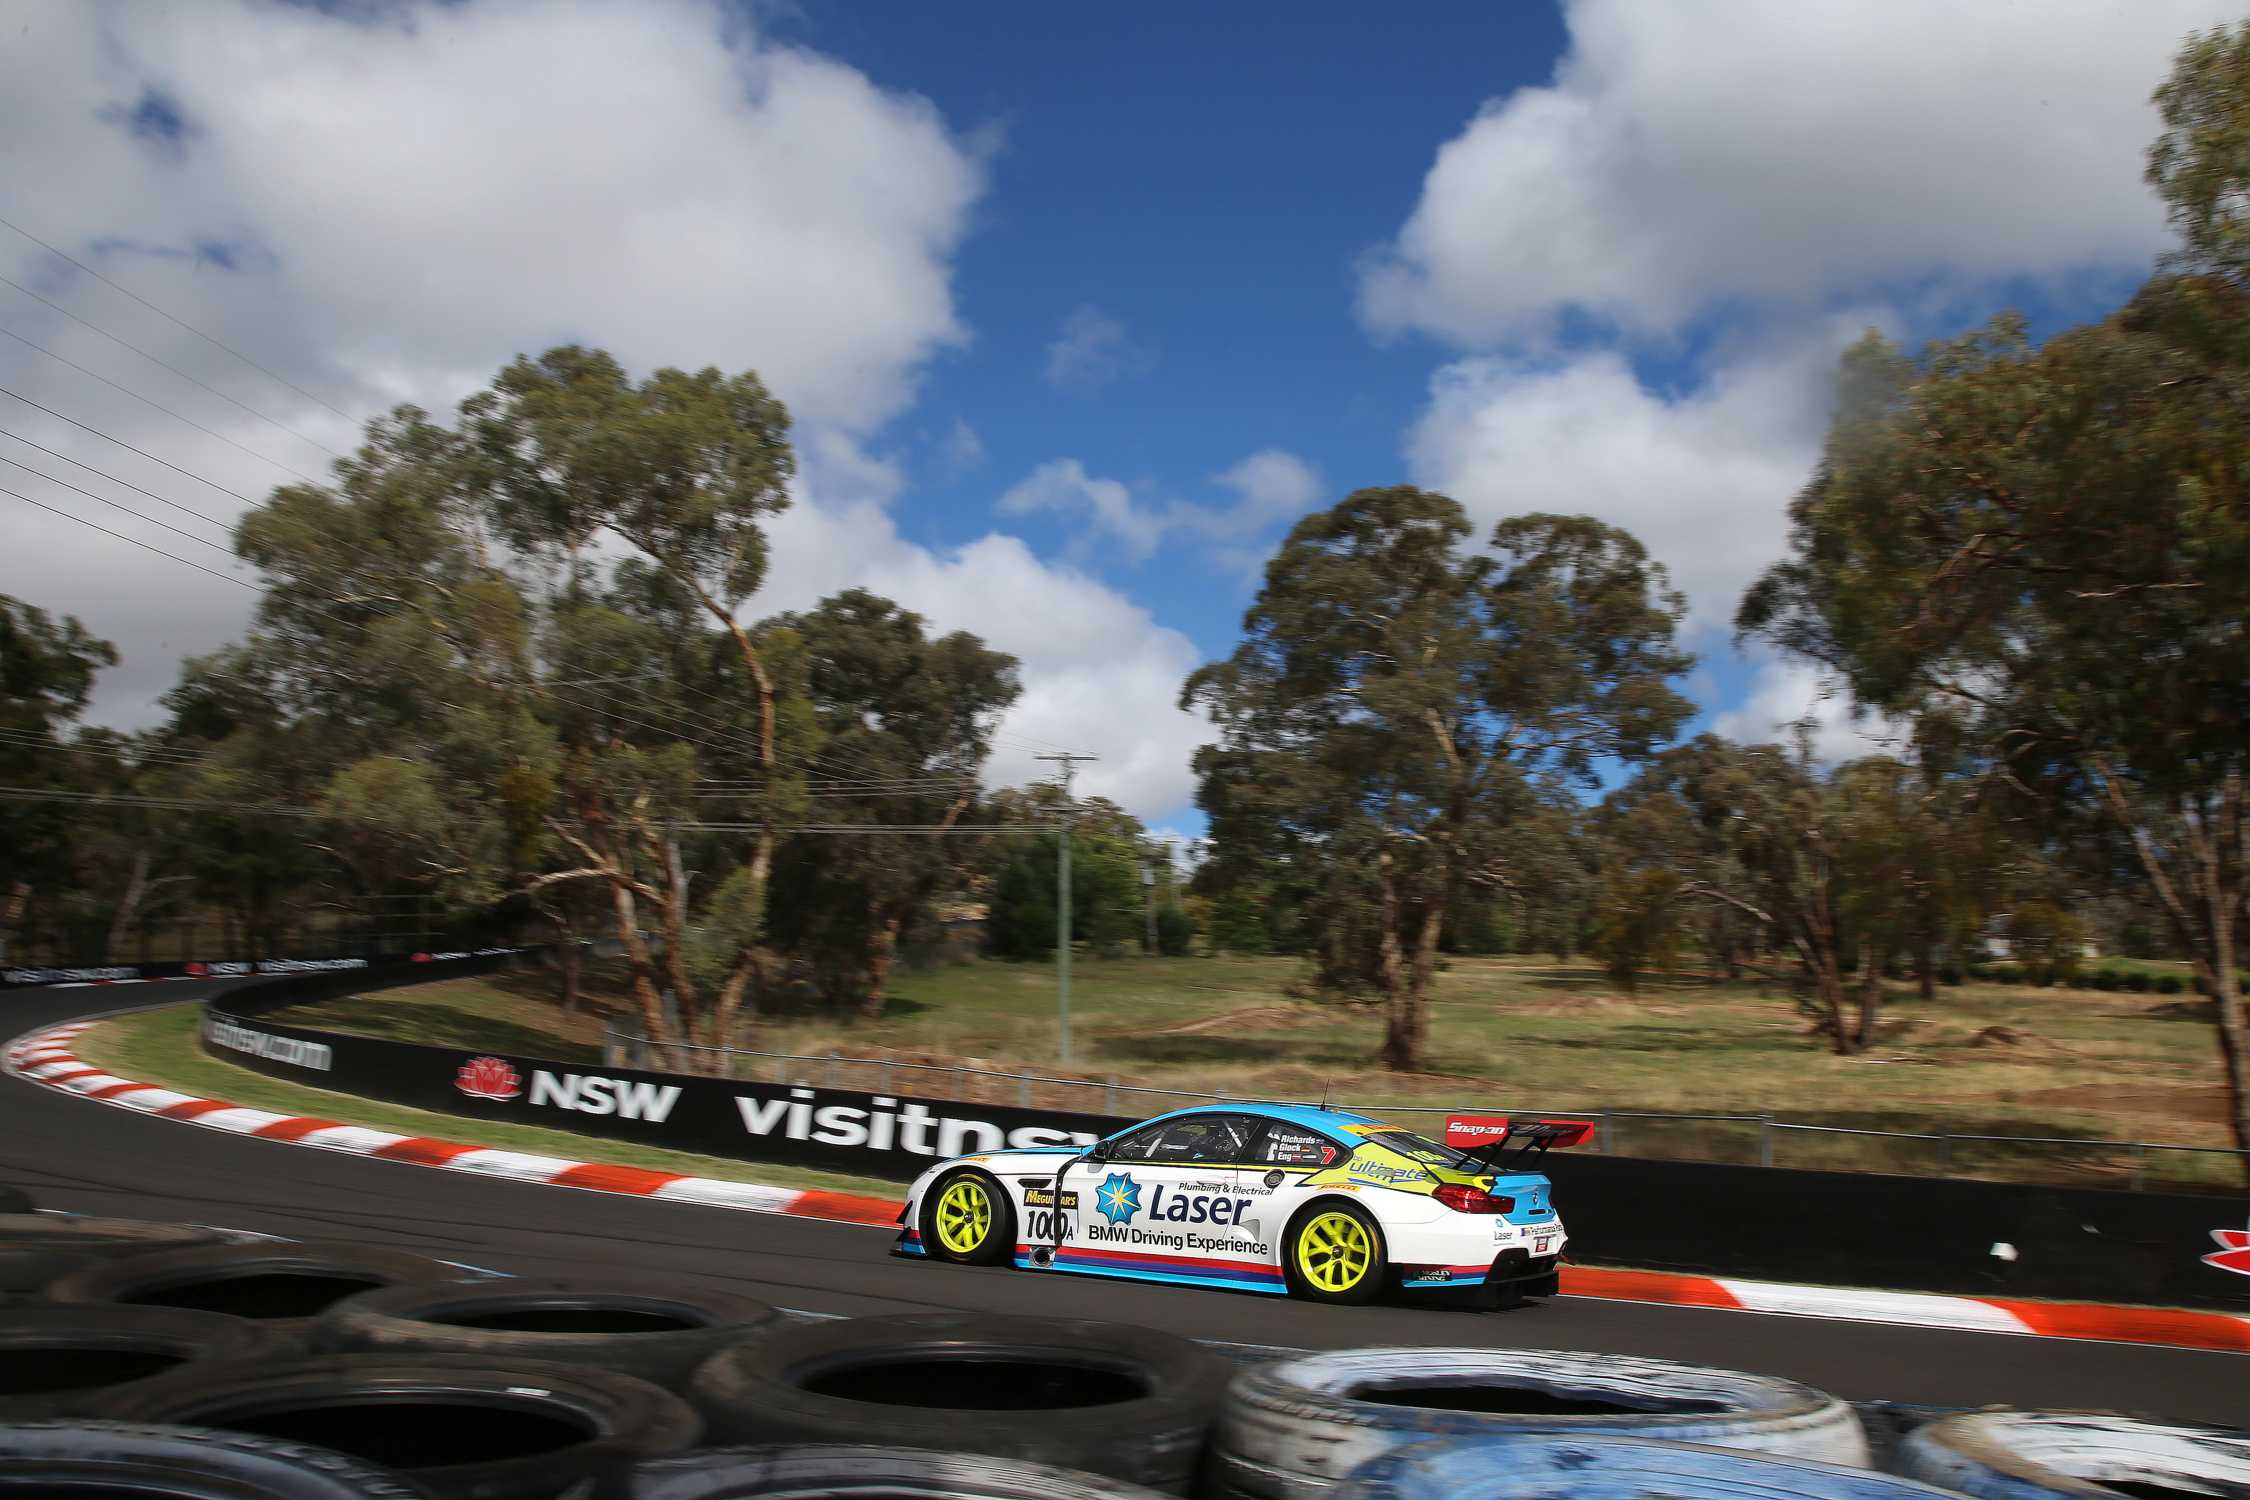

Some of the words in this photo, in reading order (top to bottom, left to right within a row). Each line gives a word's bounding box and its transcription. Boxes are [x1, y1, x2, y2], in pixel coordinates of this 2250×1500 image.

[529, 1070, 682, 1123] NSW
[734, 1088, 1101, 1158] visitns
[1447, 1122, 1505, 1135] Snap-on
[1281, 1135, 1316, 1144] Richards
[1279, 1143, 1301, 1152] Glock
[1278, 1152, 1292, 1162] Eng
[1350, 1160, 1428, 1180] ultimate
[1178, 1182, 1221, 1194] Plumbing
[1232, 1187, 1273, 1196] Electrical
[1149, 1184, 1253, 1226] Laser
[1088, 1224, 1129, 1243] BMW
[1131, 1229, 1183, 1250] Driving
[1186, 1233, 1268, 1255] Experience
[1494, 1231, 1513, 1241] Laser
